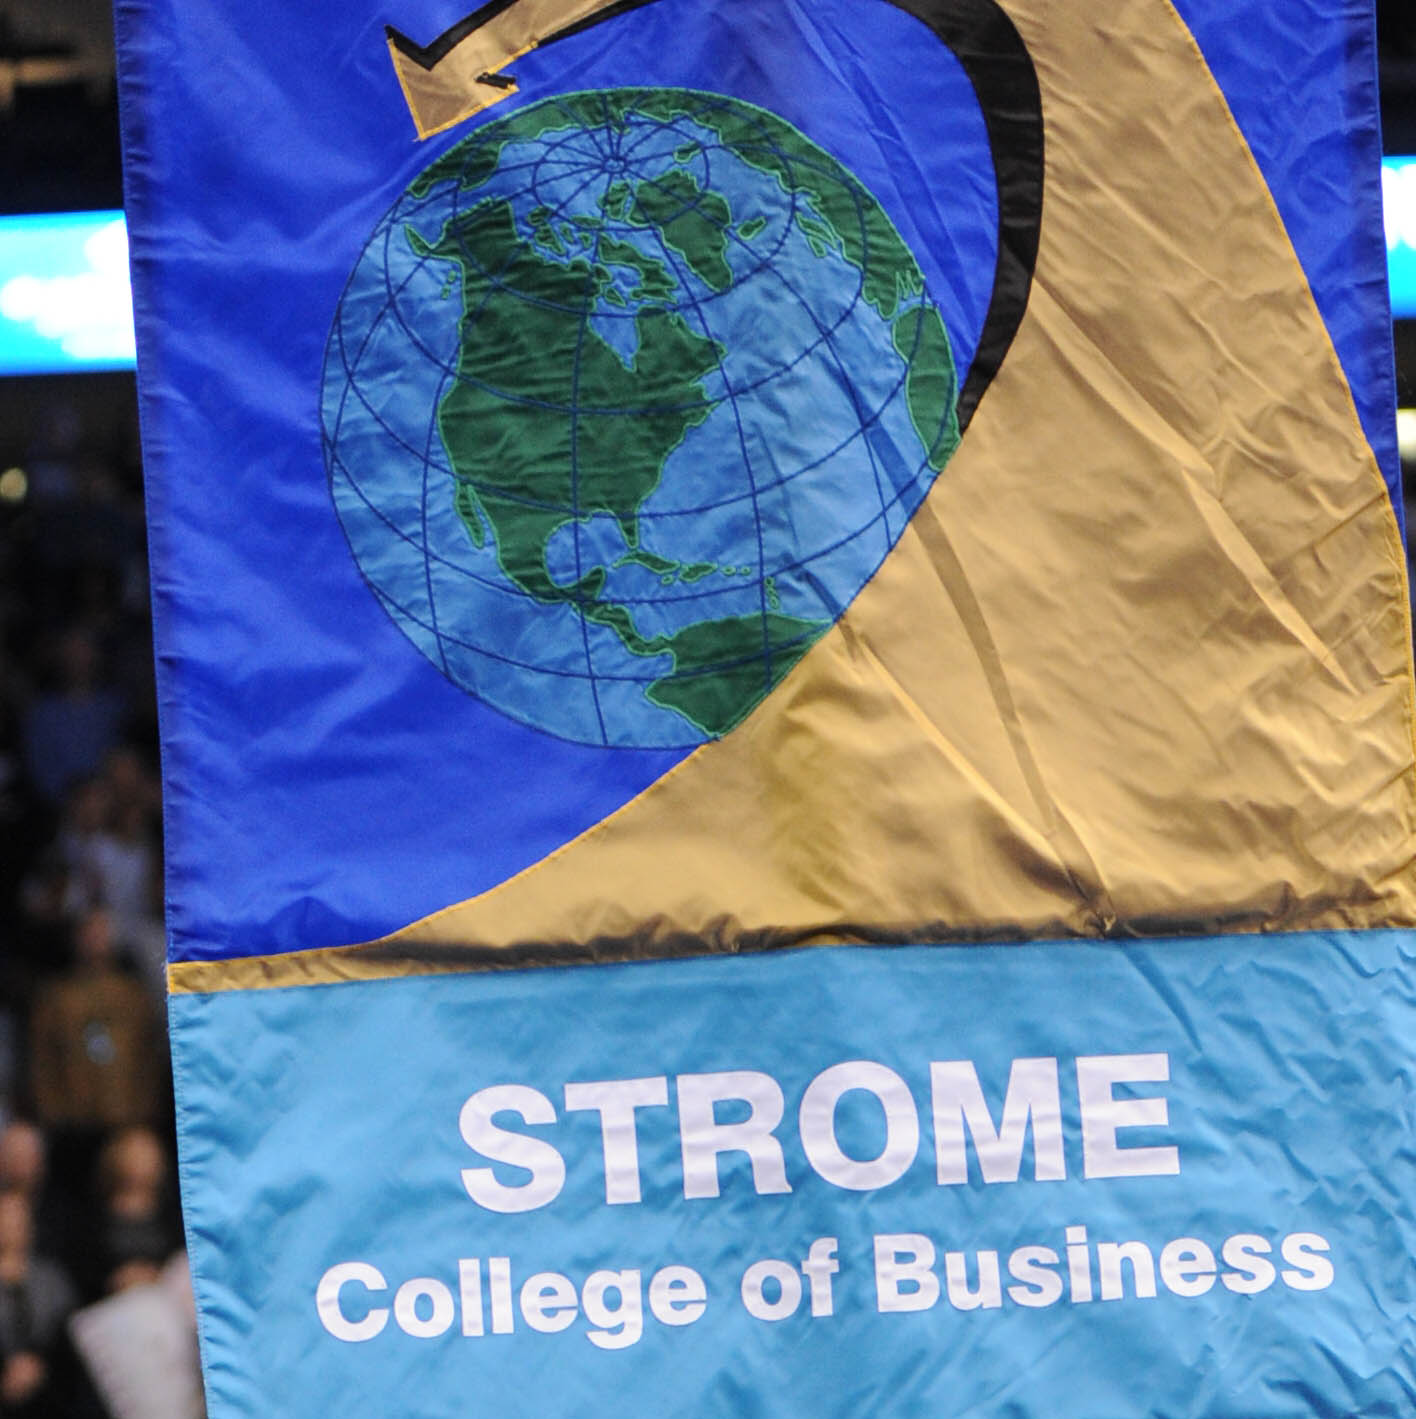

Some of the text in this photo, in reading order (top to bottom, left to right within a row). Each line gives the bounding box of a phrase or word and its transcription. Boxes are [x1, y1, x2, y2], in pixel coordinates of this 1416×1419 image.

[458, 1052, 1181, 1213] STROME
[315, 1224, 1335, 1350] College of Business
